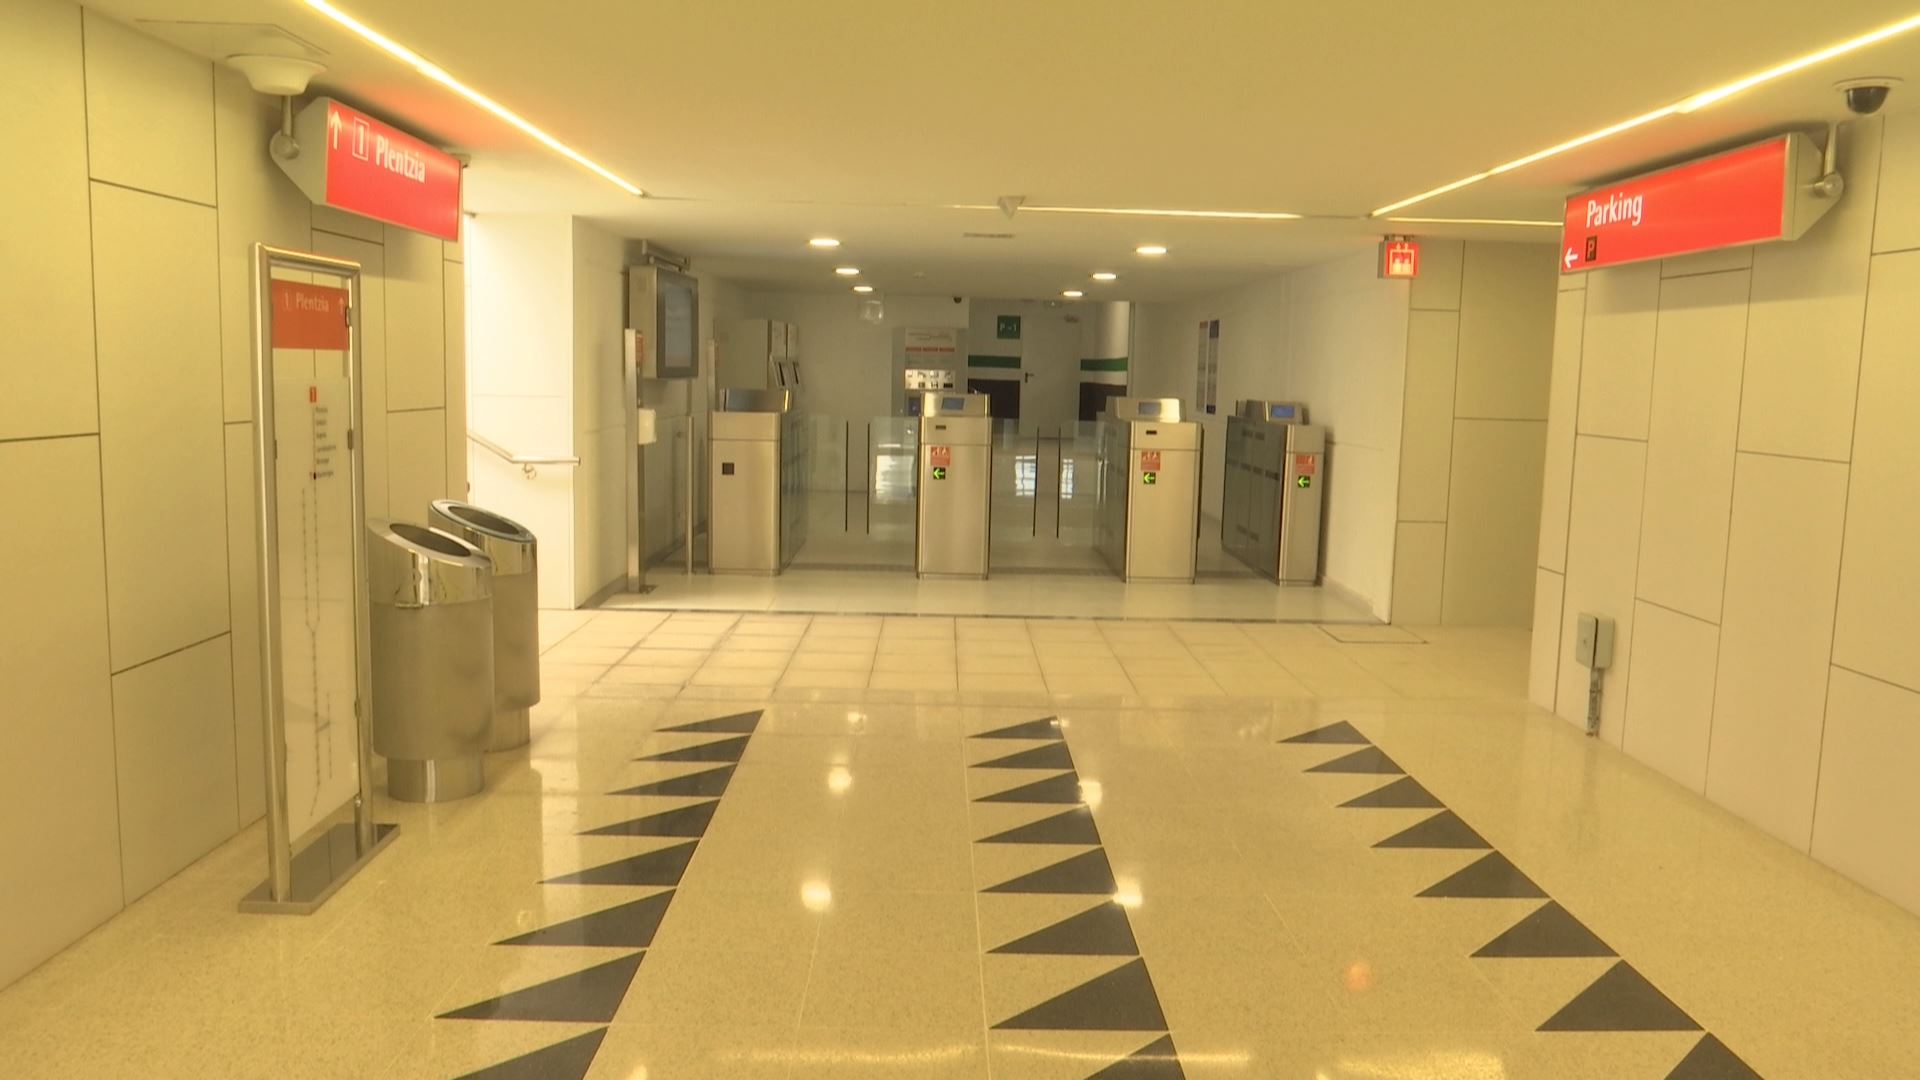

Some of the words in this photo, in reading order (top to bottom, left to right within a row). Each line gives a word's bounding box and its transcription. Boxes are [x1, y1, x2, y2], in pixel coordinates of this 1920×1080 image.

[376, 135, 426, 184] Plentzia
[1586, 192, 1643, 228] Parking
[1587, 240, 1595, 259] P
[296, 292, 329, 312] Plentzia
